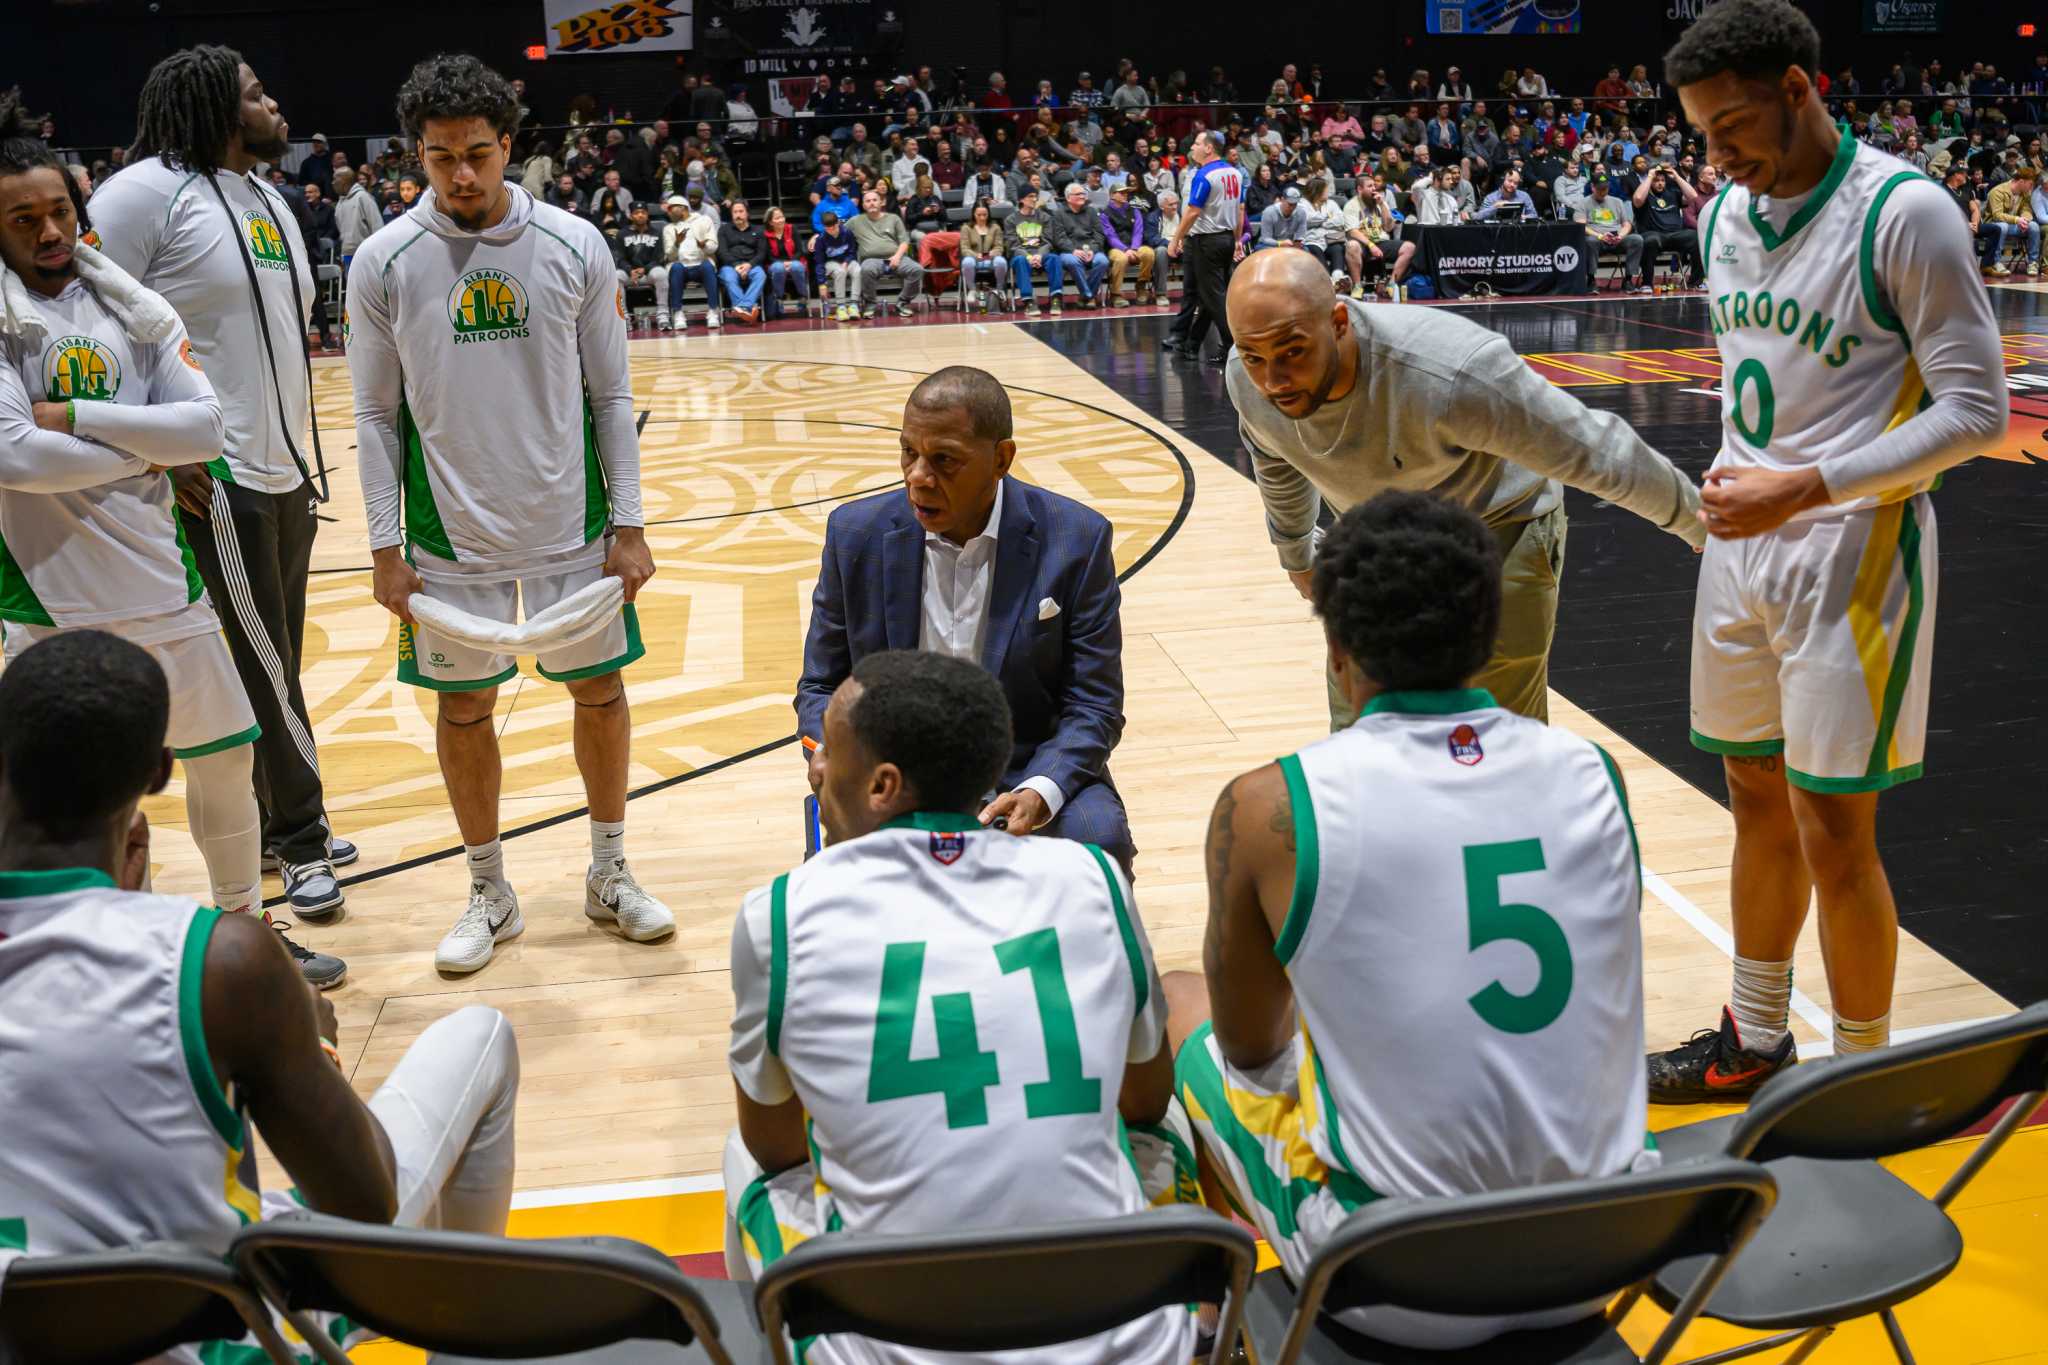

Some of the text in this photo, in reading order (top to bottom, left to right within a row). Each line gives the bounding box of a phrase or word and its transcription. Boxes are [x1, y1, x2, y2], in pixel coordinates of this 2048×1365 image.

[586, 18, 668, 48] 106
[759, 58, 788, 72] MILL
[1220, 174, 1239, 201] 140
[254, 259, 290, 272] PATROON
[1438, 253, 1575, 268] ARMORY STUDIOS NY
[463, 270, 510, 287] ALBANY
[453, 327, 530, 345] PATROONS
[1710, 290, 1863, 368] ATROONS
[56, 336, 100, 353] ALBANY
[1731, 358, 1775, 449] 0
[1462, 836, 1574, 1035] 5
[867, 926, 1102, 1130] 41
